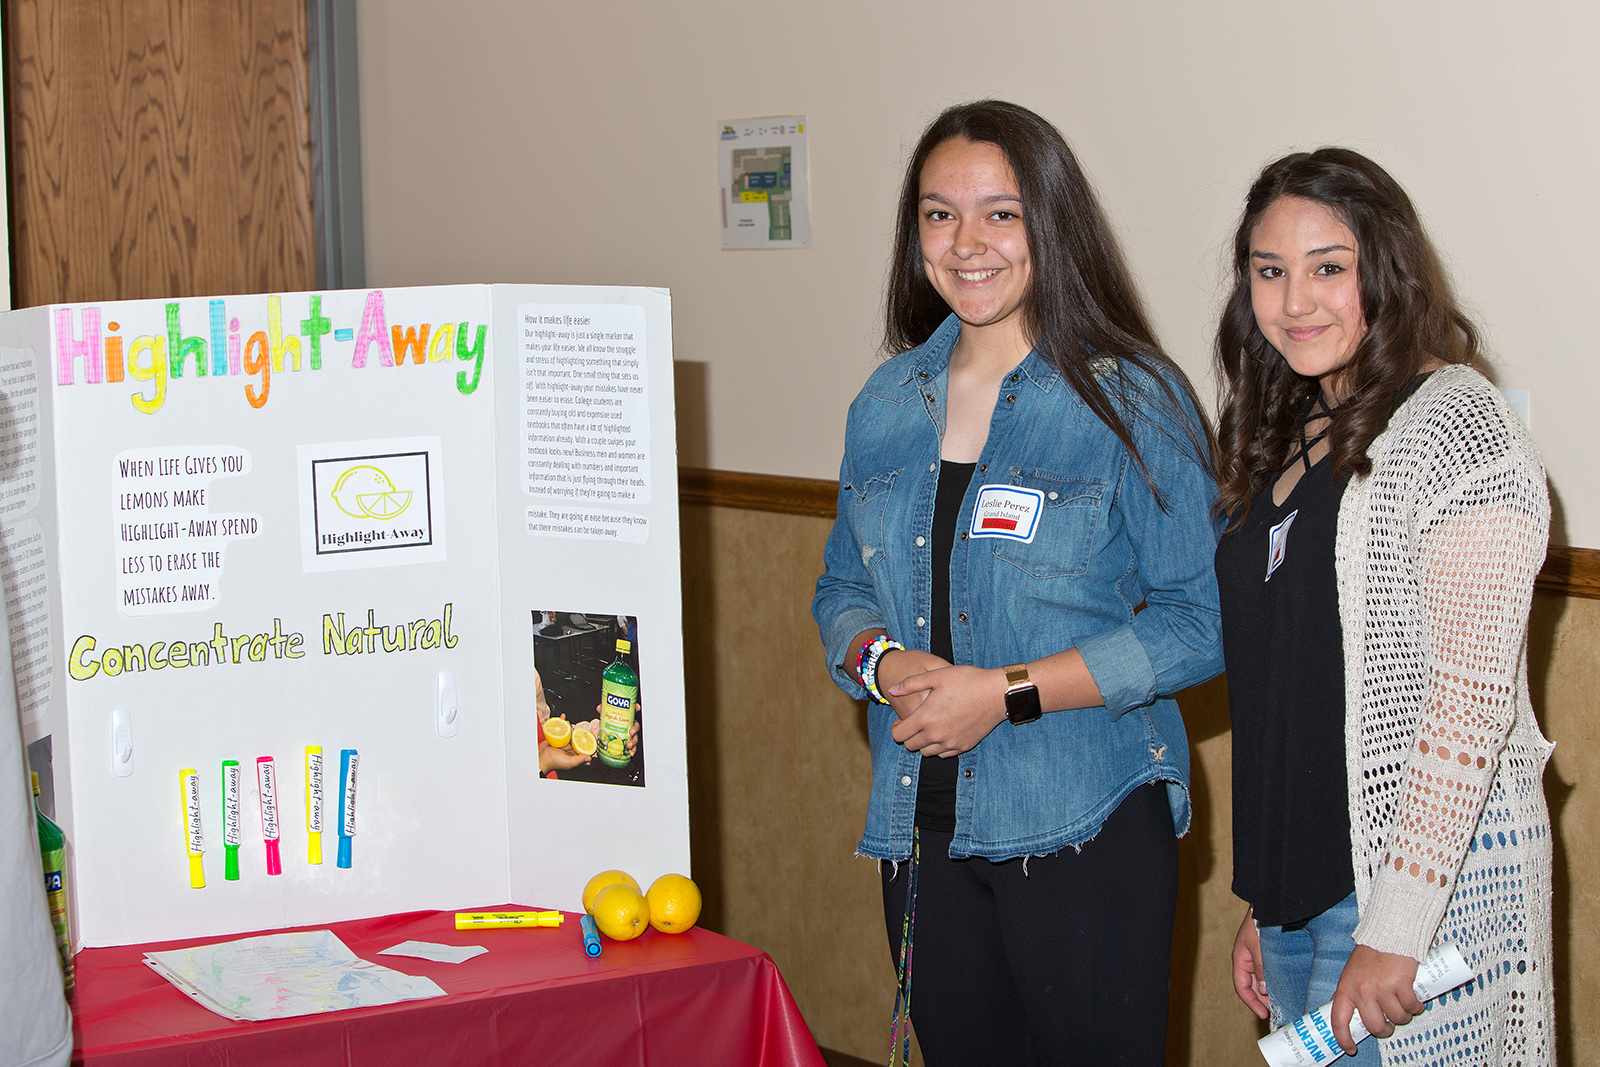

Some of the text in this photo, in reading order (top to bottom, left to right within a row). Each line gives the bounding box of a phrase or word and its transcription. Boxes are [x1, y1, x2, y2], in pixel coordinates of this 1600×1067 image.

[525, 314, 537, 324] How
[544, 315, 562, 325] makes
[563, 316, 572, 327] life
[574, 316, 590, 325] easier
[525, 329, 533, 337] Our
[535, 329, 570, 341] highlight-away
[576, 330, 585, 341] just
[590, 331, 604, 342] single
[605, 331, 622, 340] marker
[623, 332, 633, 340] that
[54, 290, 488, 415] Highlight-Away
[525, 342, 540, 350] makes
[541, 344, 551, 353] your
[561, 343, 576, 352] easier.
[593, 344, 606, 353] know
[607, 344, 615, 353] the
[616, 345, 636, 356] struggle
[526, 355, 535, 363] and
[535, 356, 549, 364] stress
[556, 356, 585, 367] highlighting
[586, 357, 611, 368] something
[612, 358, 622, 367] that
[623, 358, 639, 369] simply
[526, 368, 536, 376] isn't
[537, 368, 547, 377] that
[548, 368, 572, 380] important.
[573, 369, 582, 378] One
[583, 370, 596, 379] small
[597, 370, 610, 381] thing
[611, 371, 621, 379] that
[622, 372, 631, 380] sets
[526, 381, 534, 392] off.
[535, 381, 546, 390] With
[547, 382, 584, 393] highlight-away
[584, 385, 594, 394] your
[595, 383, 616, 392] mistakes
[617, 384, 628, 393] have
[527, 394, 538, 403] been
[539, 394, 553, 403] easier
[575, 396, 592, 407] College
[593, 397, 613, 406] students
[527, 407, 622, 421] constantly buying old and expensive used
[527, 420, 550, 429] textbooks
[551, 421, 560, 430] that
[561, 421, 573, 432] often
[574, 422, 585, 431] have
[603, 423, 631, 435] highlighted
[528, 433, 555, 445] information
[556, 434, 574, 445] already.
[575, 435, 586, 444] With
[591, 436, 606, 447] couple
[607, 437, 624, 448] swipes
[625, 439, 636, 448] your
[528, 445, 548, 455] textbook
[549, 447, 561, 455] looks
[562, 447, 574, 456] new!
[575, 448, 595, 457] Business
[608, 450, 617, 458] and
[528, 459, 639, 475] constantly dealing with numbers and important
[529, 472, 556, 484] information
[557, 473, 566, 482] that
[572, 474, 582, 485] just
[583, 475, 596, 486] flying
[597, 475, 616, 487] through
[617, 476, 628, 485] their
[630, 477, 646, 486] heads.
[529, 485, 546, 494] Instead
[553, 486, 574, 497] worrying
[579, 487, 596, 499] they're
[597, 488, 610, 499] going
[618, 489, 630, 498] make
[981, 499, 1031, 513] Leslie Perez
[528, 509, 548, 518] mistake.
[549, 510, 560, 521] They
[569, 511, 583, 523] going
[602, 514, 621, 523] because
[622, 515, 633, 526] they
[634, 516, 647, 525] know
[1000, 511, 1021, 520] Island
[528, 522, 538, 531] that
[539, 523, 551, 532] there
[552, 523, 573, 533] mistakes
[590, 526, 604, 535] taken
[605, 529, 618, 538] away.
[983, 520, 1016, 531] Red Group
[322, 529, 426, 546] Highlight-Away
[68, 603, 459, 681] Concentrate Natural
[608, 695, 630, 708] GOYA
[309, 753, 323, 832] Highlight-away
[226, 767, 240, 845] Highlight-away
[262, 763, 277, 840] Highlight-away
[188, 775, 203, 853] Highlight-away
